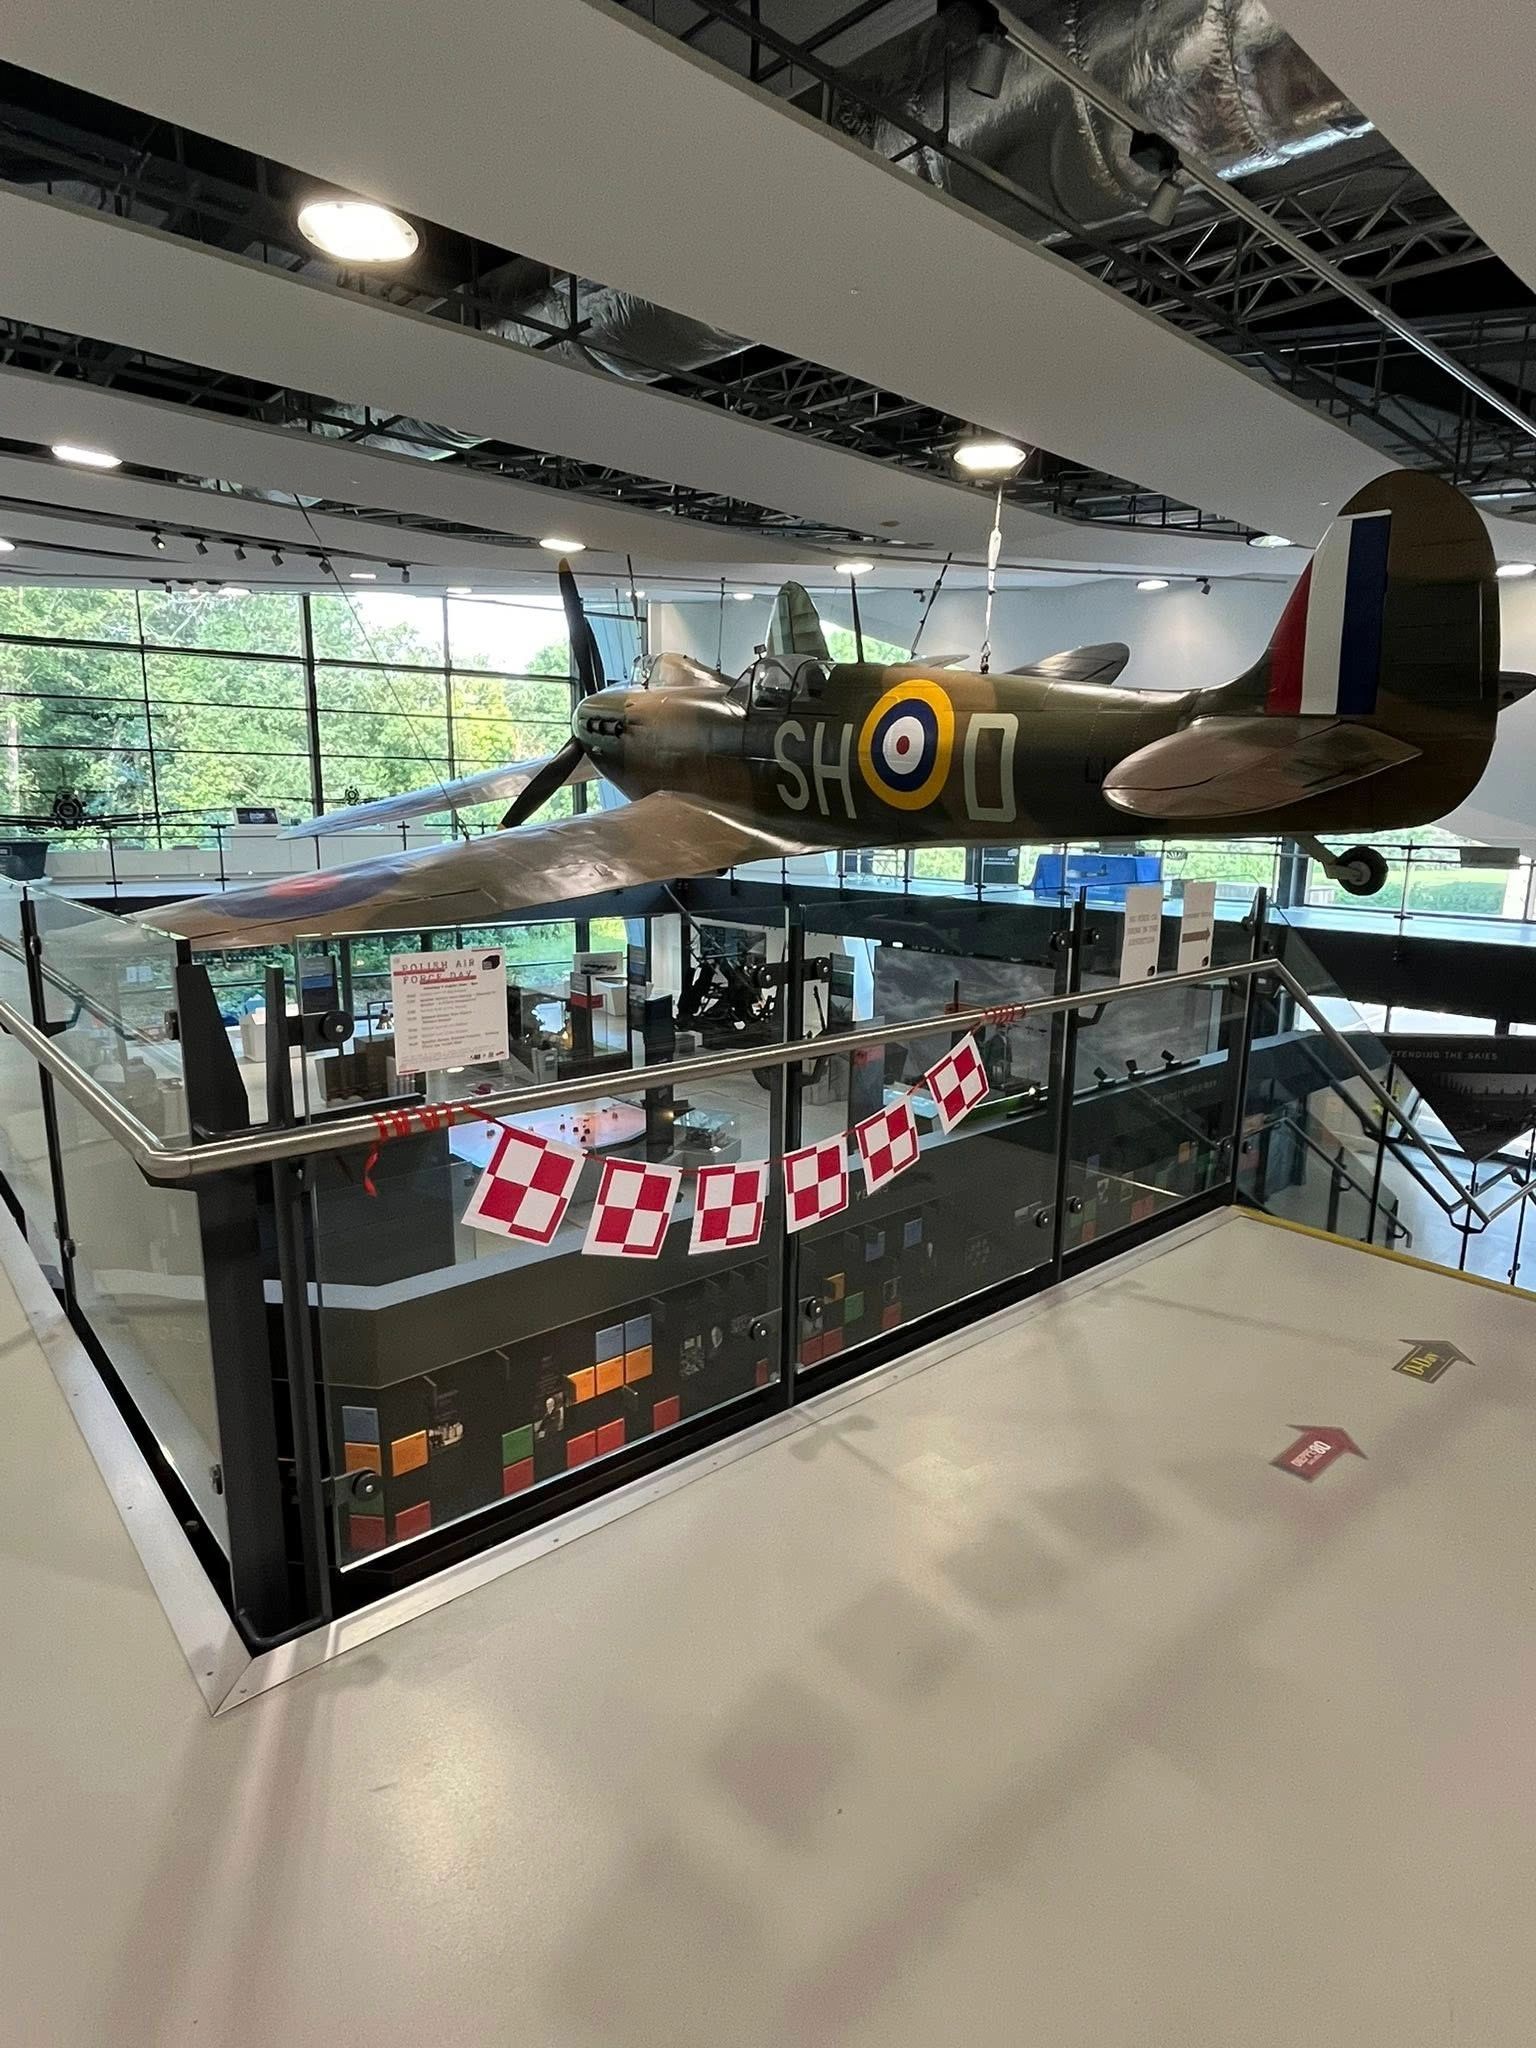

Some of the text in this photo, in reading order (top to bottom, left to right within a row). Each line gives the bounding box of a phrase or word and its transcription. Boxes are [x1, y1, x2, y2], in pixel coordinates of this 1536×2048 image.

[774, 720, 857, 819] SH
[402, 959, 475, 971] POLISH AIR
[403, 970, 472, 984] FORCE DAY
[1390, 1049, 1498, 1061] EFENDING THE SKIES
[1309, 1440, 1332, 1455] 80
